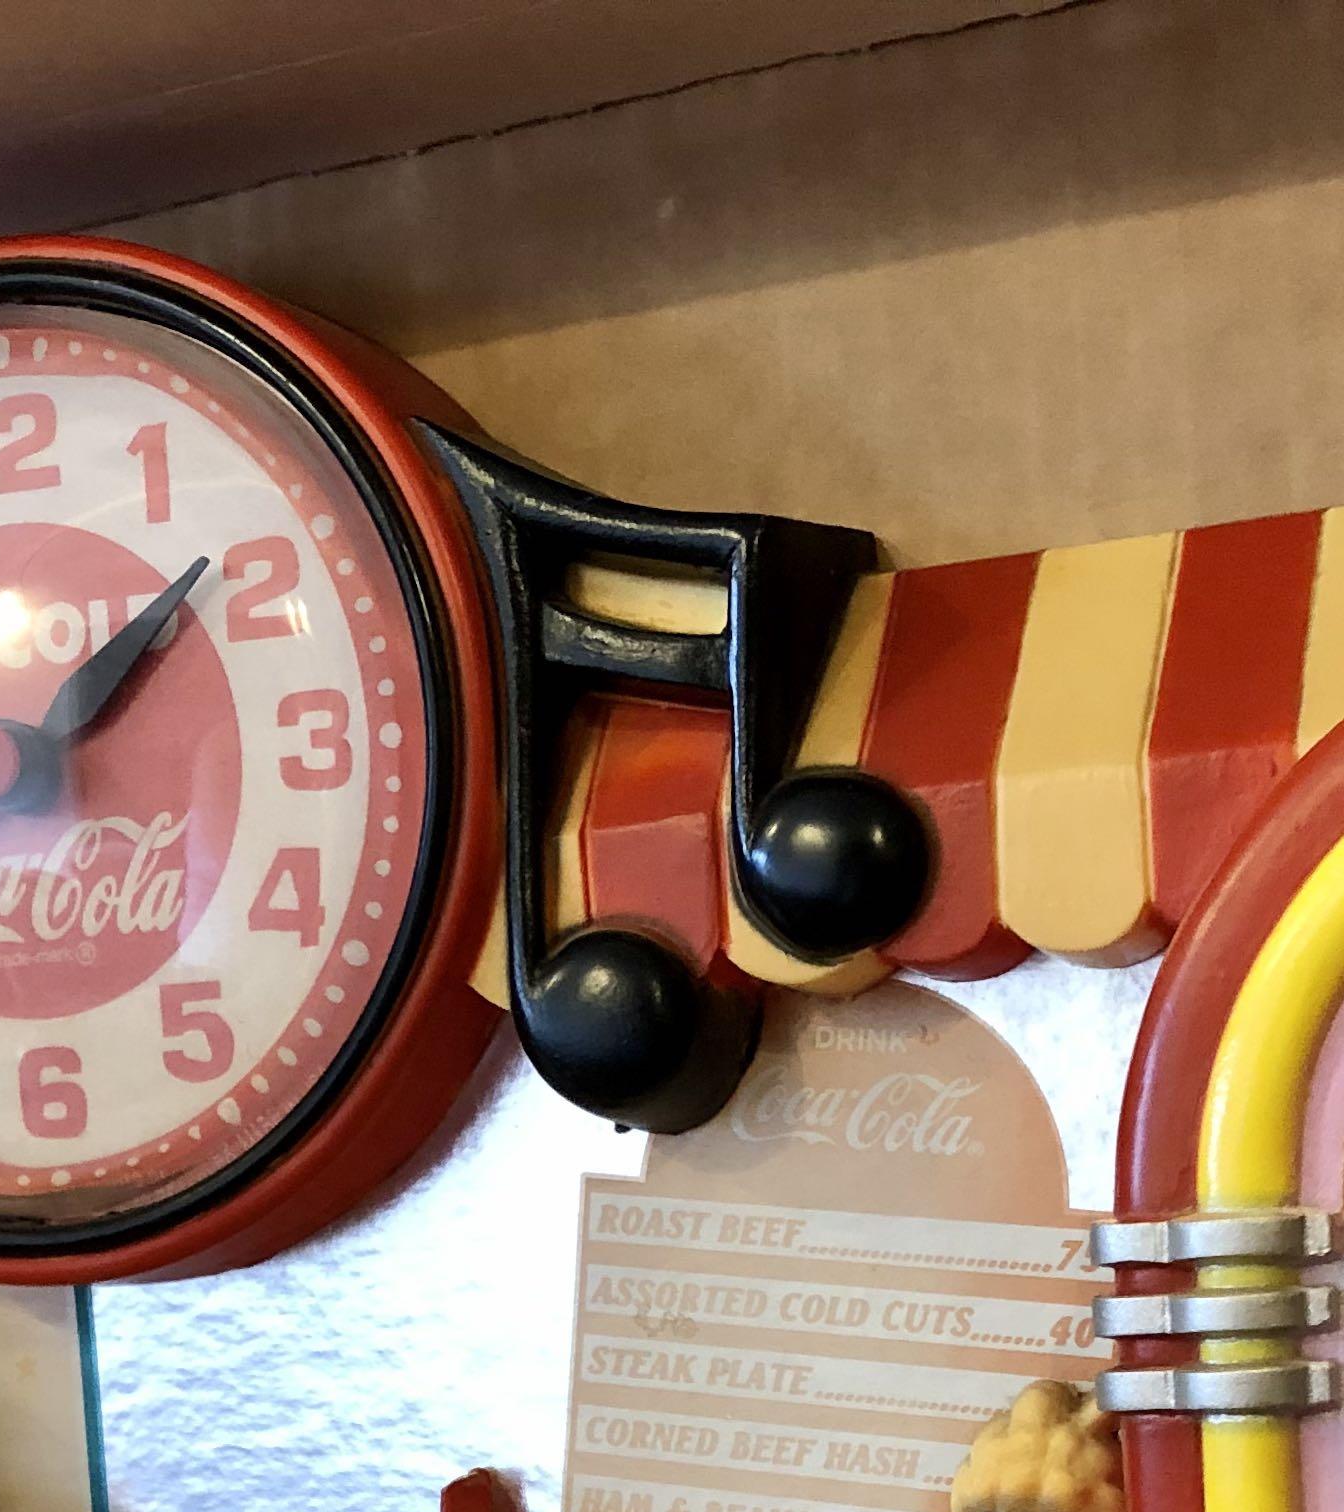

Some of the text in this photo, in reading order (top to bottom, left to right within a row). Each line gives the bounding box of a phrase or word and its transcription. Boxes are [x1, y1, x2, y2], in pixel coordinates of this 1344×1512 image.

[126, 422, 173, 524] 1
[222, 534, 303, 642] 2
[276, 687, 353, 792] 3
[248, 846, 325, 948] 4
[159, 980, 236, 1083] 5
[814, 1024, 908, 1053] DRINK
[19, 1045, 89, 1140] 6
[596, 1203, 712, 1241] ROAST
[718, 1213, 807, 1248] BEEF
[591, 1276, 1096, 1348] ASSORTED COLD CUTS 40
[586, 1346, 815, 1396] STEAK PLATE
[585, 1415, 922, 1479] CORNED BEEF HASH
